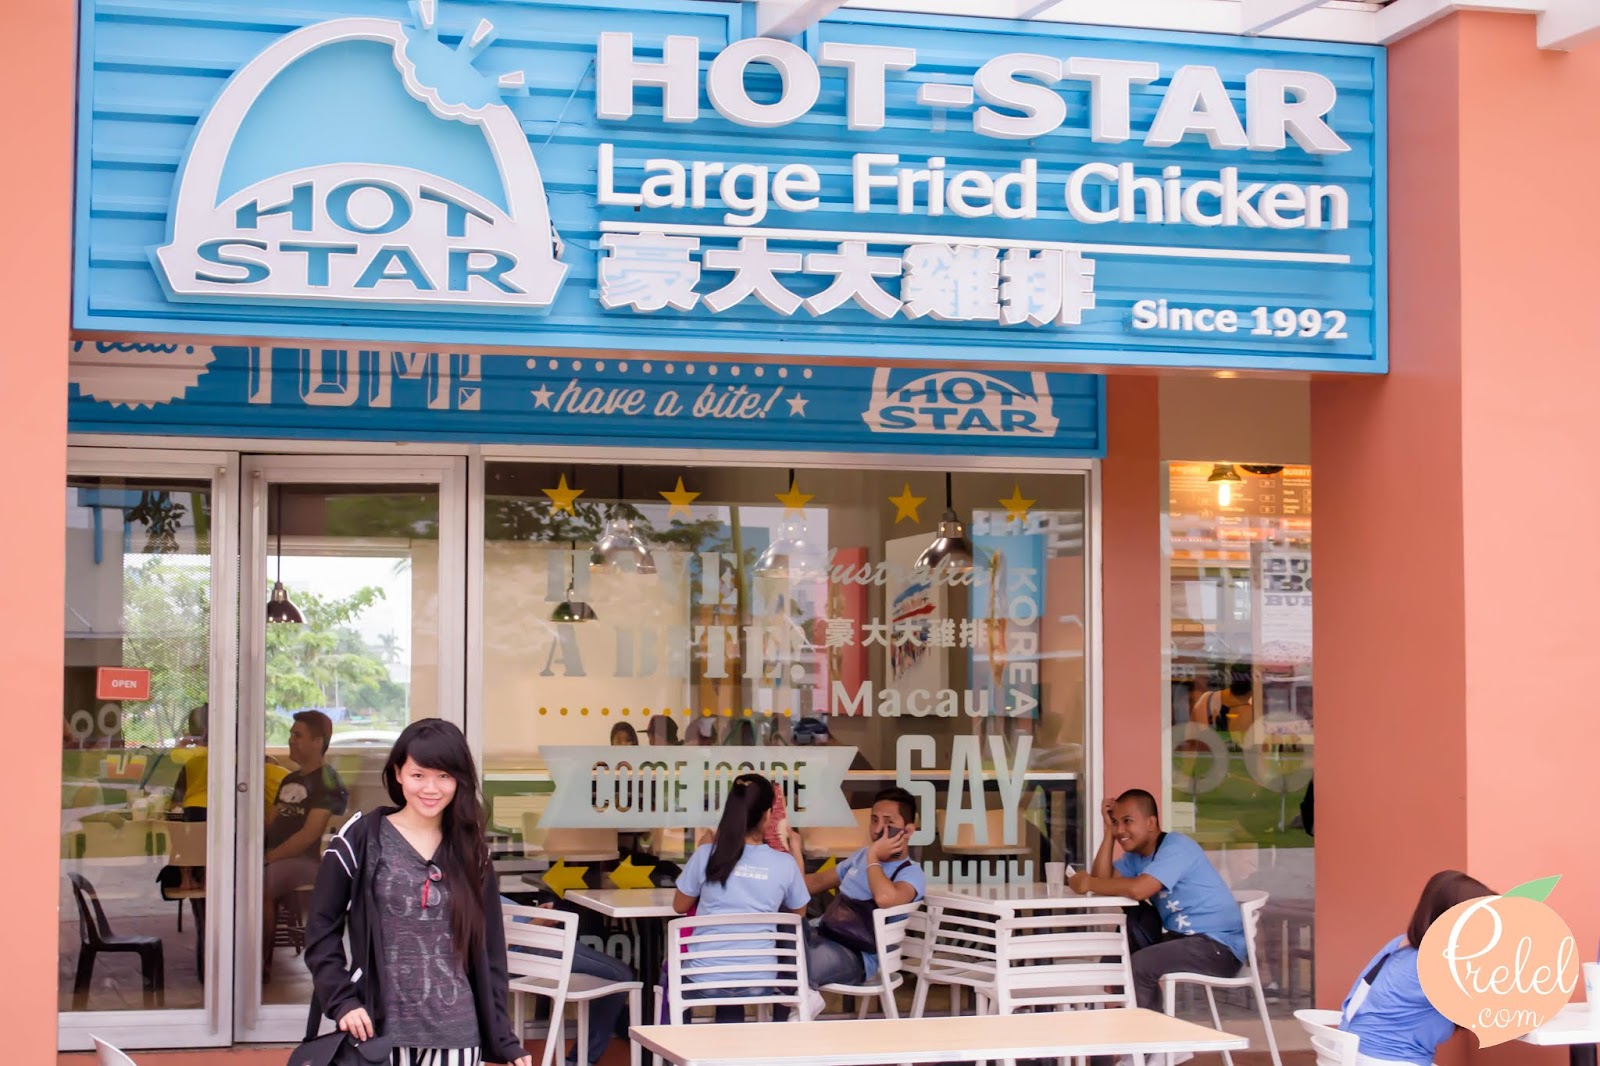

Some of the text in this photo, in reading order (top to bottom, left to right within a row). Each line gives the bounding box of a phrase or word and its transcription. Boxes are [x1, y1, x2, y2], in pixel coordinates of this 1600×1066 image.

[597, 32, 1352, 155] HOT-STAR
[235, 178, 494, 238] HOT
[598, 143, 1348, 230] Large Fried Chicken
[195, 238, 528, 294] STAR
[1131, 299, 1348, 340] Since 1992
[553, 378, 784, 419] have a bite!
[898, 377, 1026, 405] HOT
[879, 405, 1044, 433] STAR
[1006, 567, 1038, 717] KOREA
[111, 679, 137, 689] OPEN
[831, 680, 989, 718] Macau
[591, 760, 688, 812] COME
[896, 734, 1033, 846] SAY
